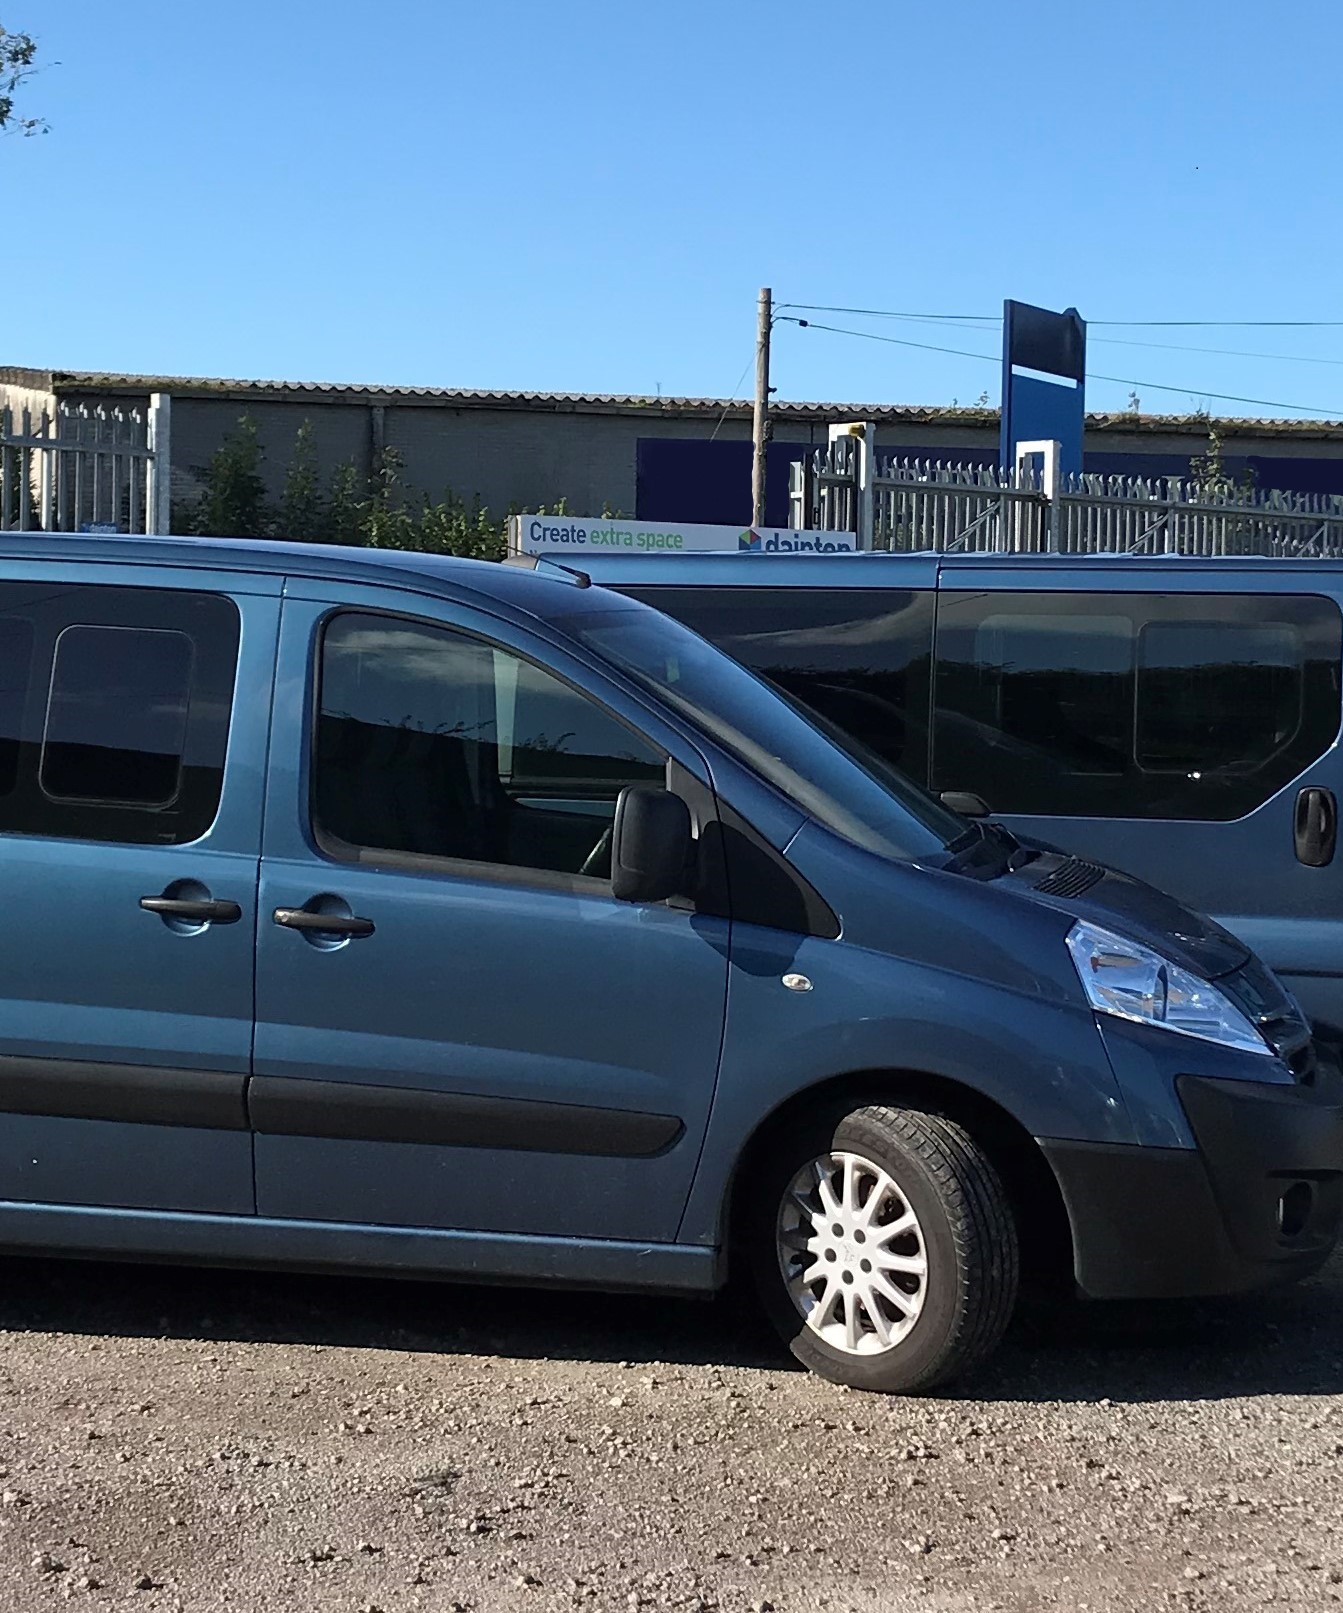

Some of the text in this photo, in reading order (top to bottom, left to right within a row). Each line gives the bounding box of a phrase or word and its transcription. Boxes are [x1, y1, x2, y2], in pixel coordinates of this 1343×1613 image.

[530, 521, 683, 551] Create extra space
